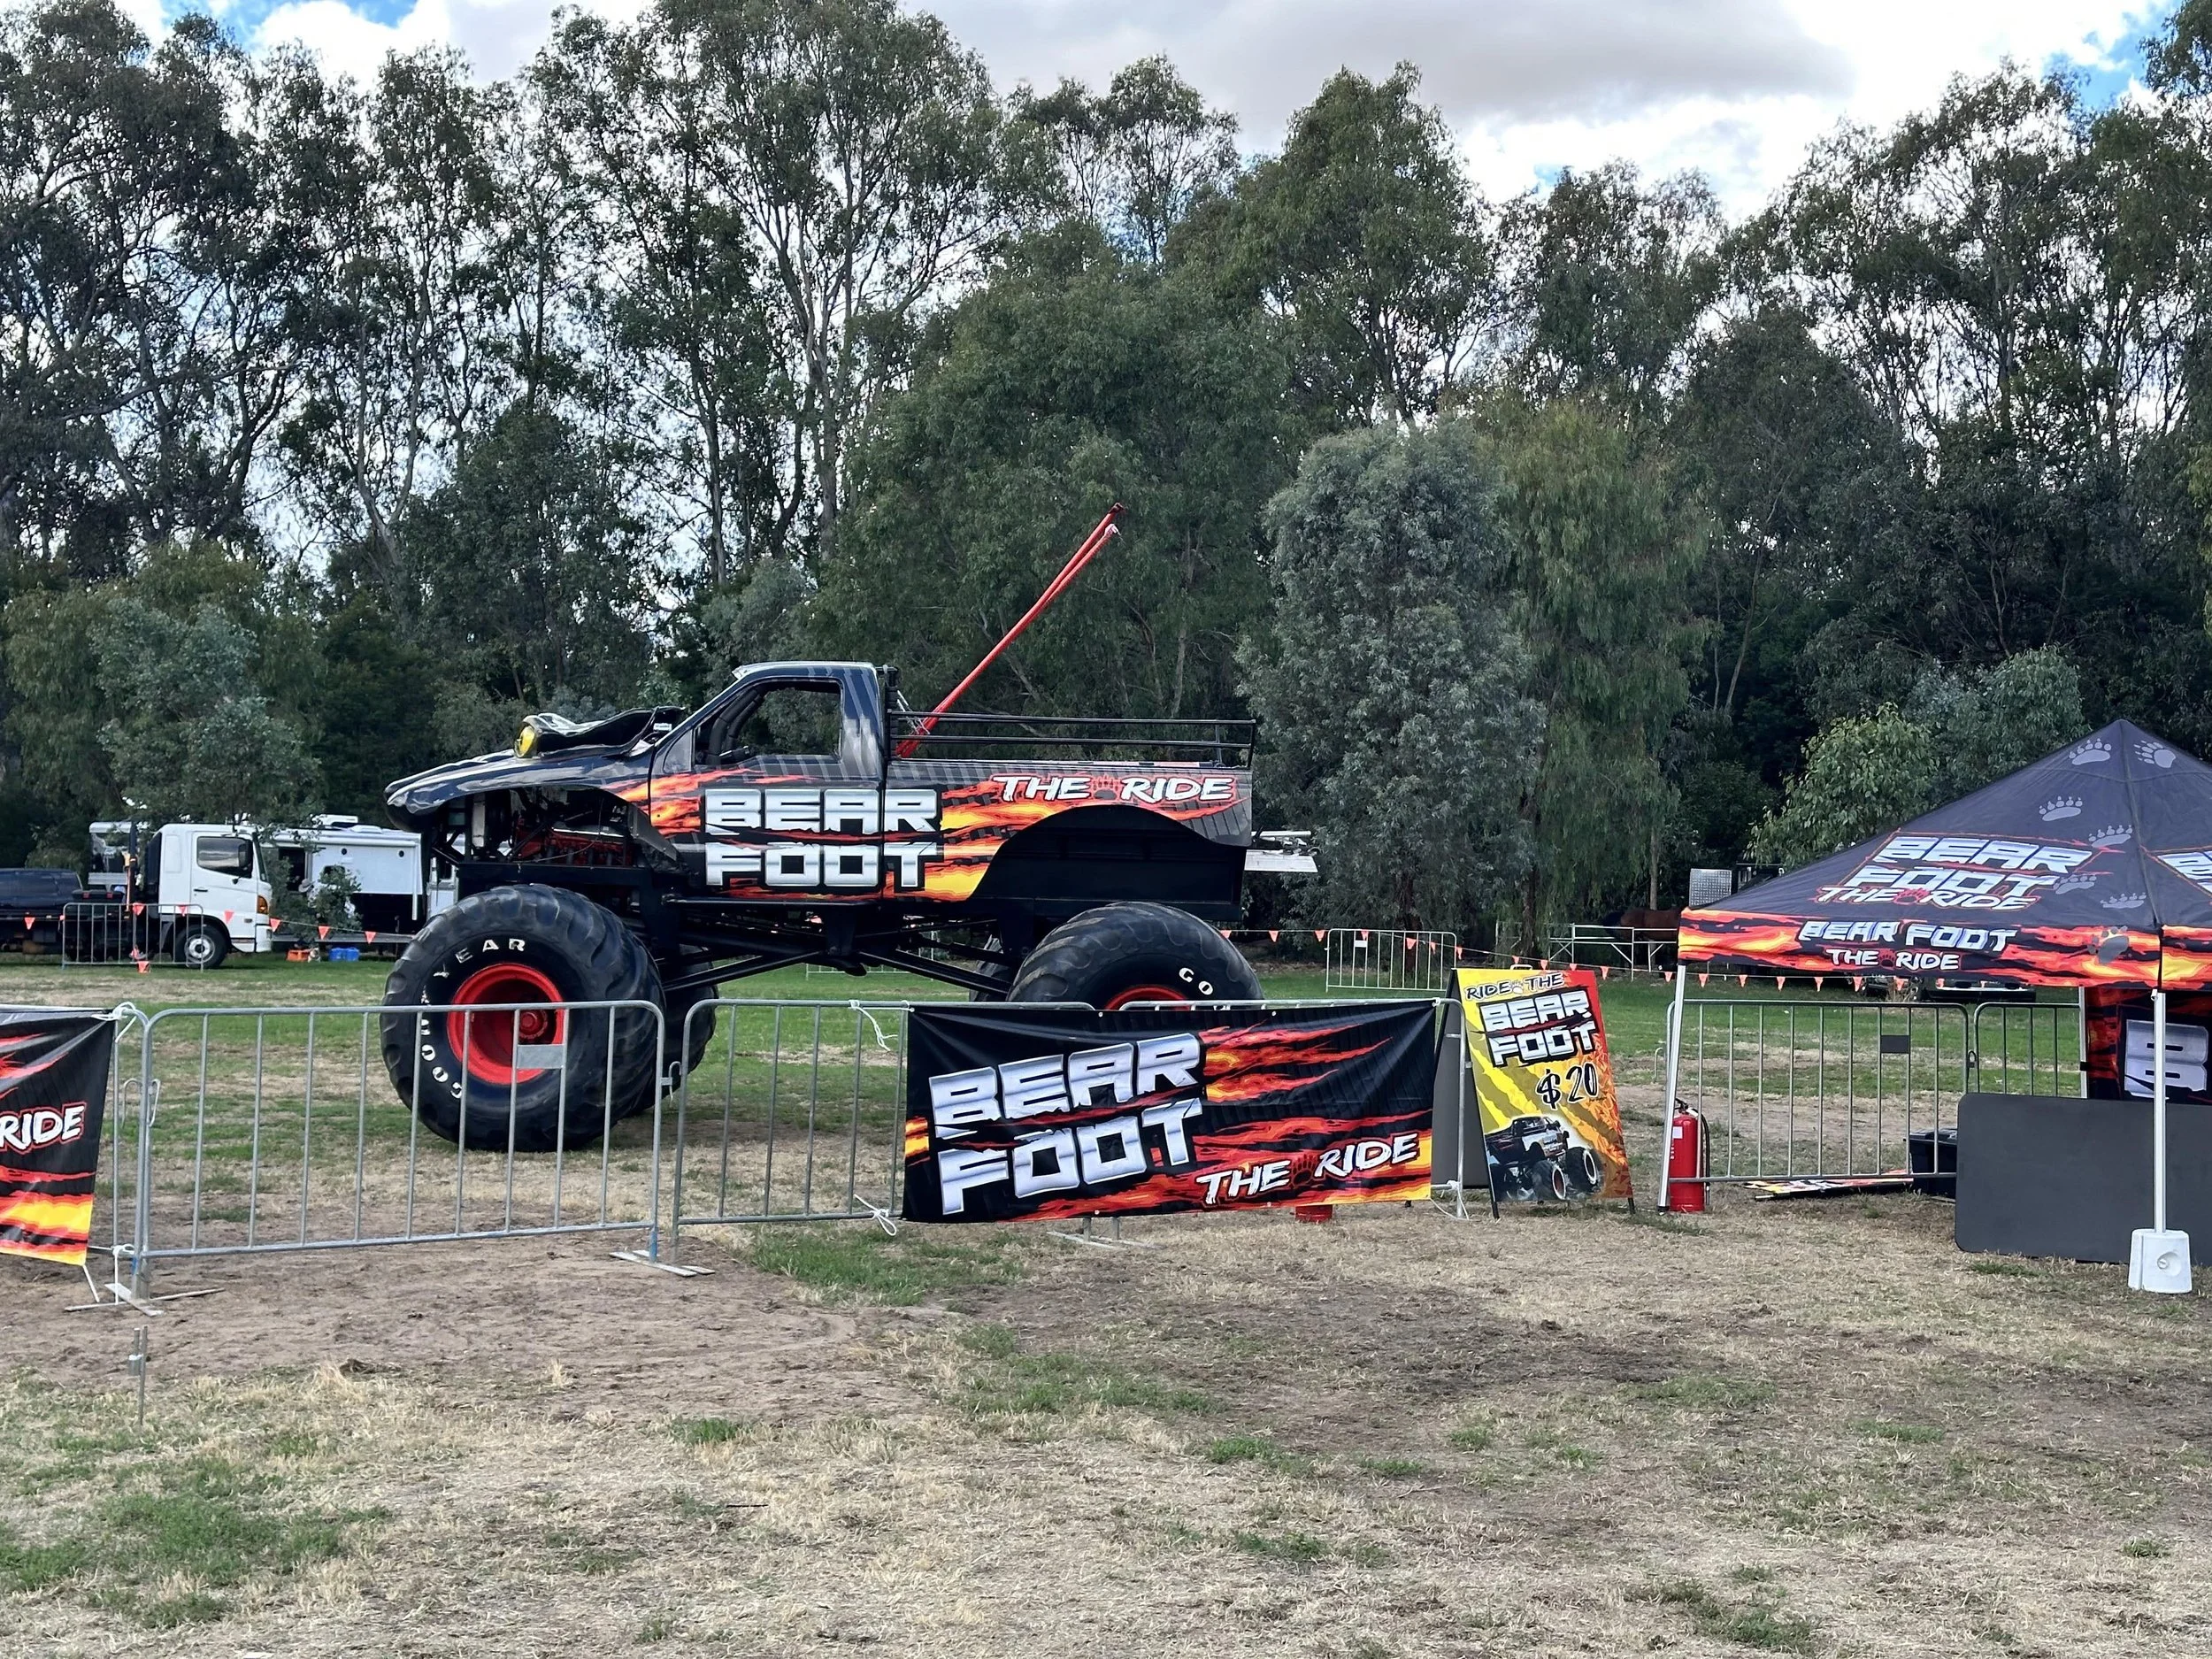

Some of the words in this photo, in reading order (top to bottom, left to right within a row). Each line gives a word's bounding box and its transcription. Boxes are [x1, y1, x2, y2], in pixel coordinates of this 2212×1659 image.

[705, 788, 937, 835] BEAR
[992, 776, 1092, 803] THE
[1120, 776, 1235, 804] RIDE
[705, 841, 937, 887] FOOT
[1872, 836, 2092, 873] BEAR
[1816, 887, 1904, 903] THE
[1918, 888, 2037, 910] RIDE
[1844, 865, 2061, 897] FOOT
[1798, 921, 1901, 943] BEAR
[1905, 923, 2020, 952] FOOT
[1825, 949, 1879, 967] THE
[1895, 950, 1960, 971] RIDE
[1465, 981, 1511, 1000] RIDE
[1525, 973, 1564, 991] THE
[1480, 990, 1592, 1033] BEAR
[1488, 1021, 1596, 1066] FOOT
[929, 1033, 1200, 1139] BEAR
[1536, 1064, 1598, 1110] $20
[0, 1105, 85, 1150] RIDE
[937, 1098, 1203, 1215] FOOT
[1195, 1166, 1292, 1204] THE
[1313, 1133, 1420, 1179] RIDE
